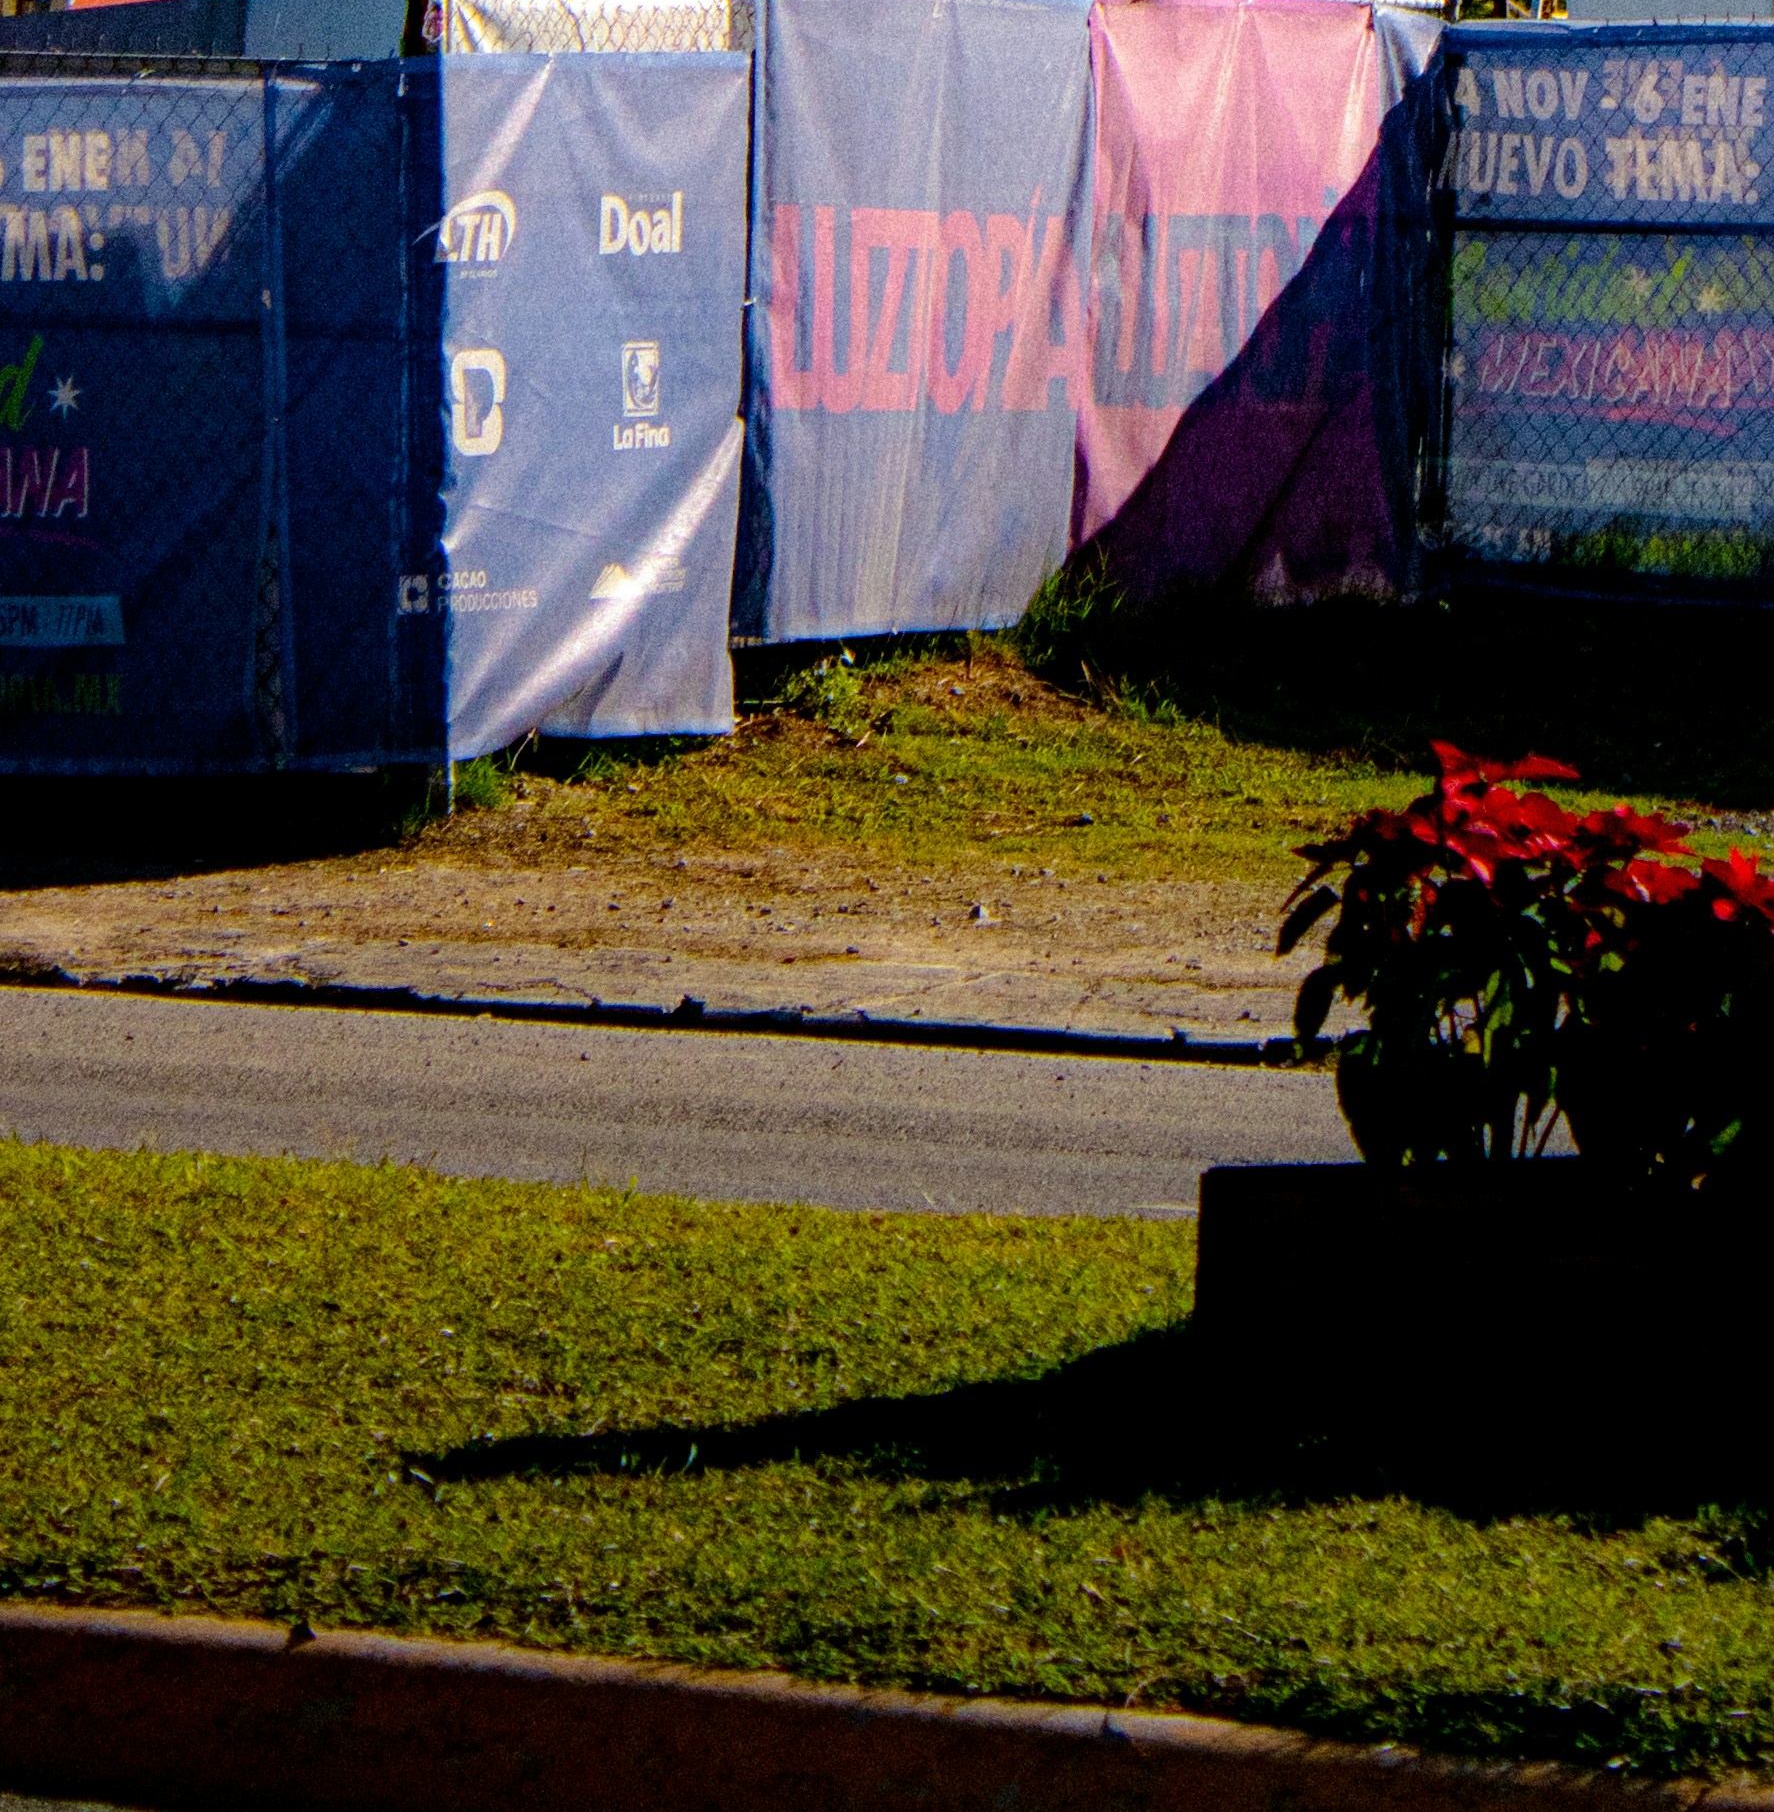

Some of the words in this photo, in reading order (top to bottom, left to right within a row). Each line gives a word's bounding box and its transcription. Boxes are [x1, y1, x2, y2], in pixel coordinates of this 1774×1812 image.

[1492, 68, 1589, 121] NOV
[1635, 72, 1663, 124] 6
[1681, 74, 1767, 126] ENE
[435, 214, 503, 263] LTH
[598, 190, 685, 256] Doal
[770, 185, 1085, 414] LUZTOPÍA
[437, 570, 487, 591] CACAO
[437, 589, 538, 613] PRODUCCIONES
